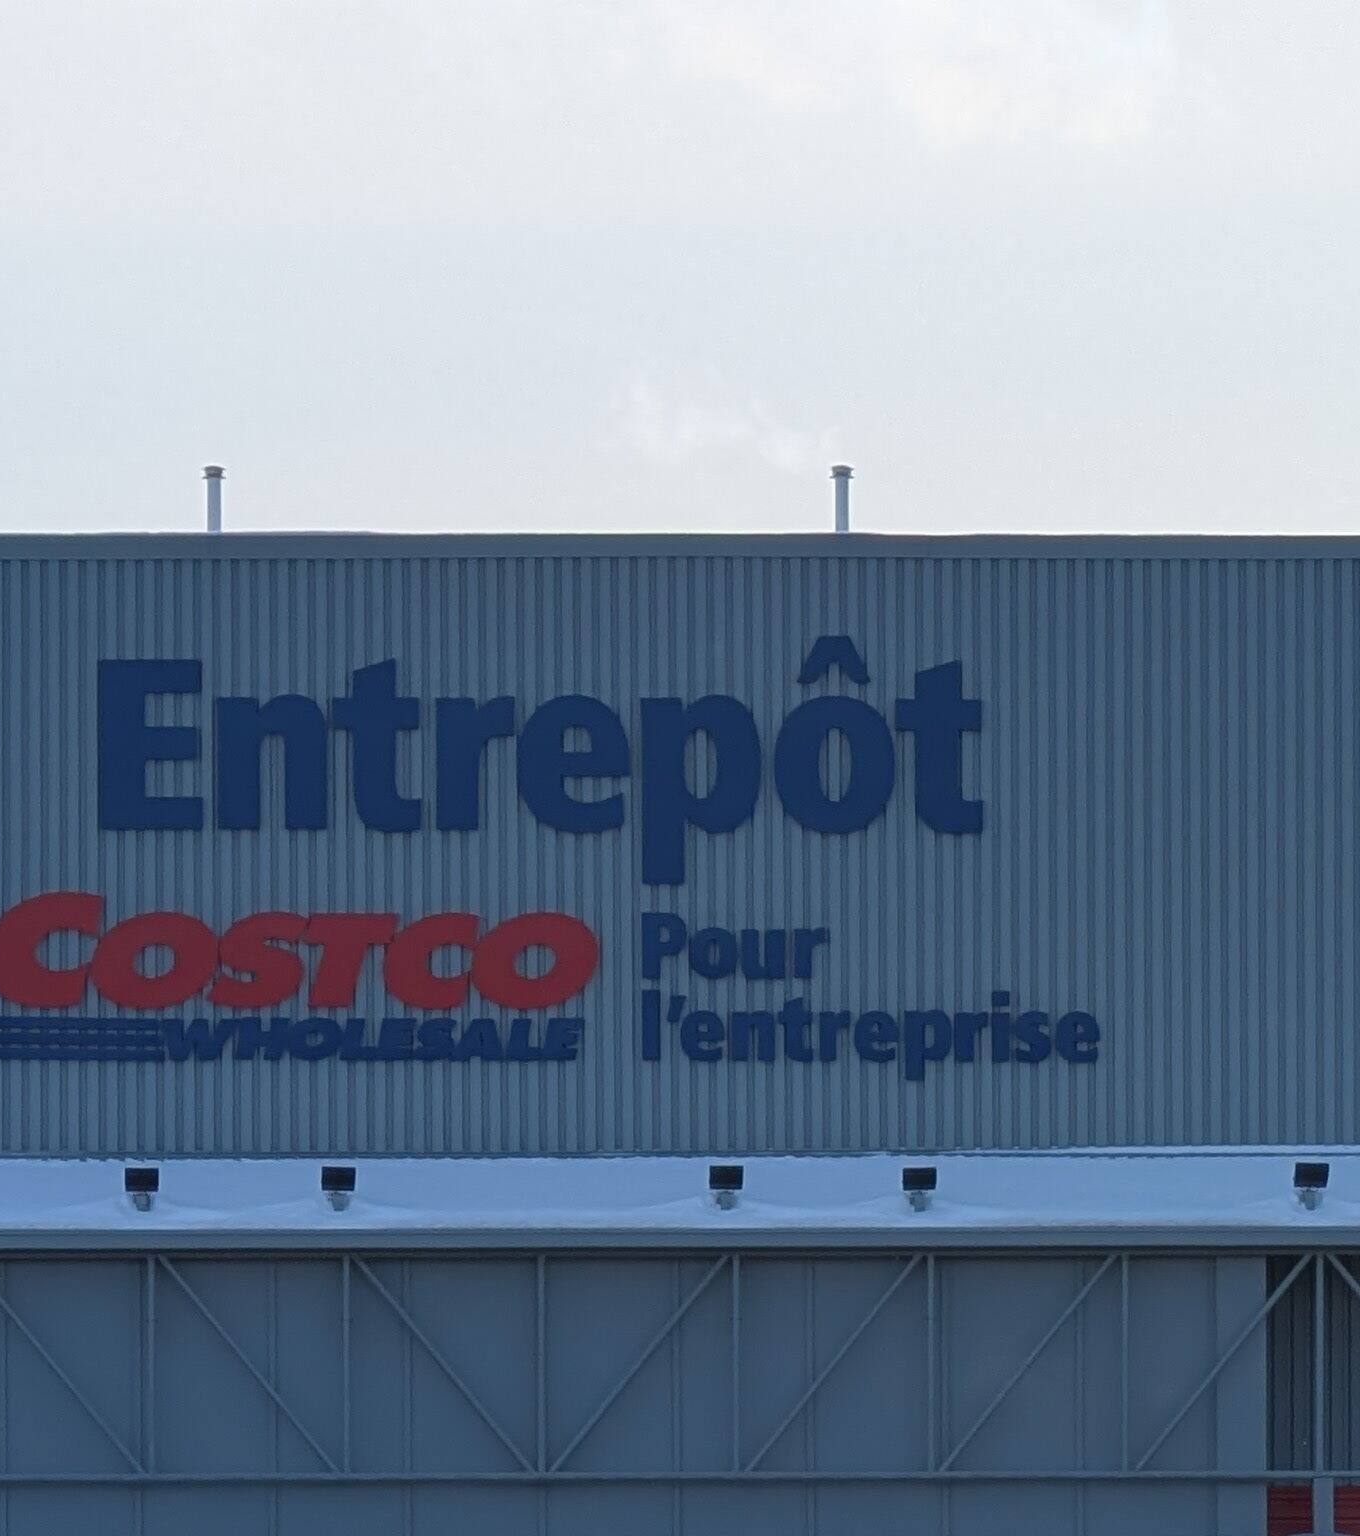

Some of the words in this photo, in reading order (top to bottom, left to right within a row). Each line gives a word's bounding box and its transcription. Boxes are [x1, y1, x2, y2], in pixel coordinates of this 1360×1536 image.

[97, 635, 984, 886] Entrepôt
[641, 911, 831, 980] Pour
[162, 1017, 586, 1062] WHOLESALE
[641, 989, 1101, 1082] l'entreprise
